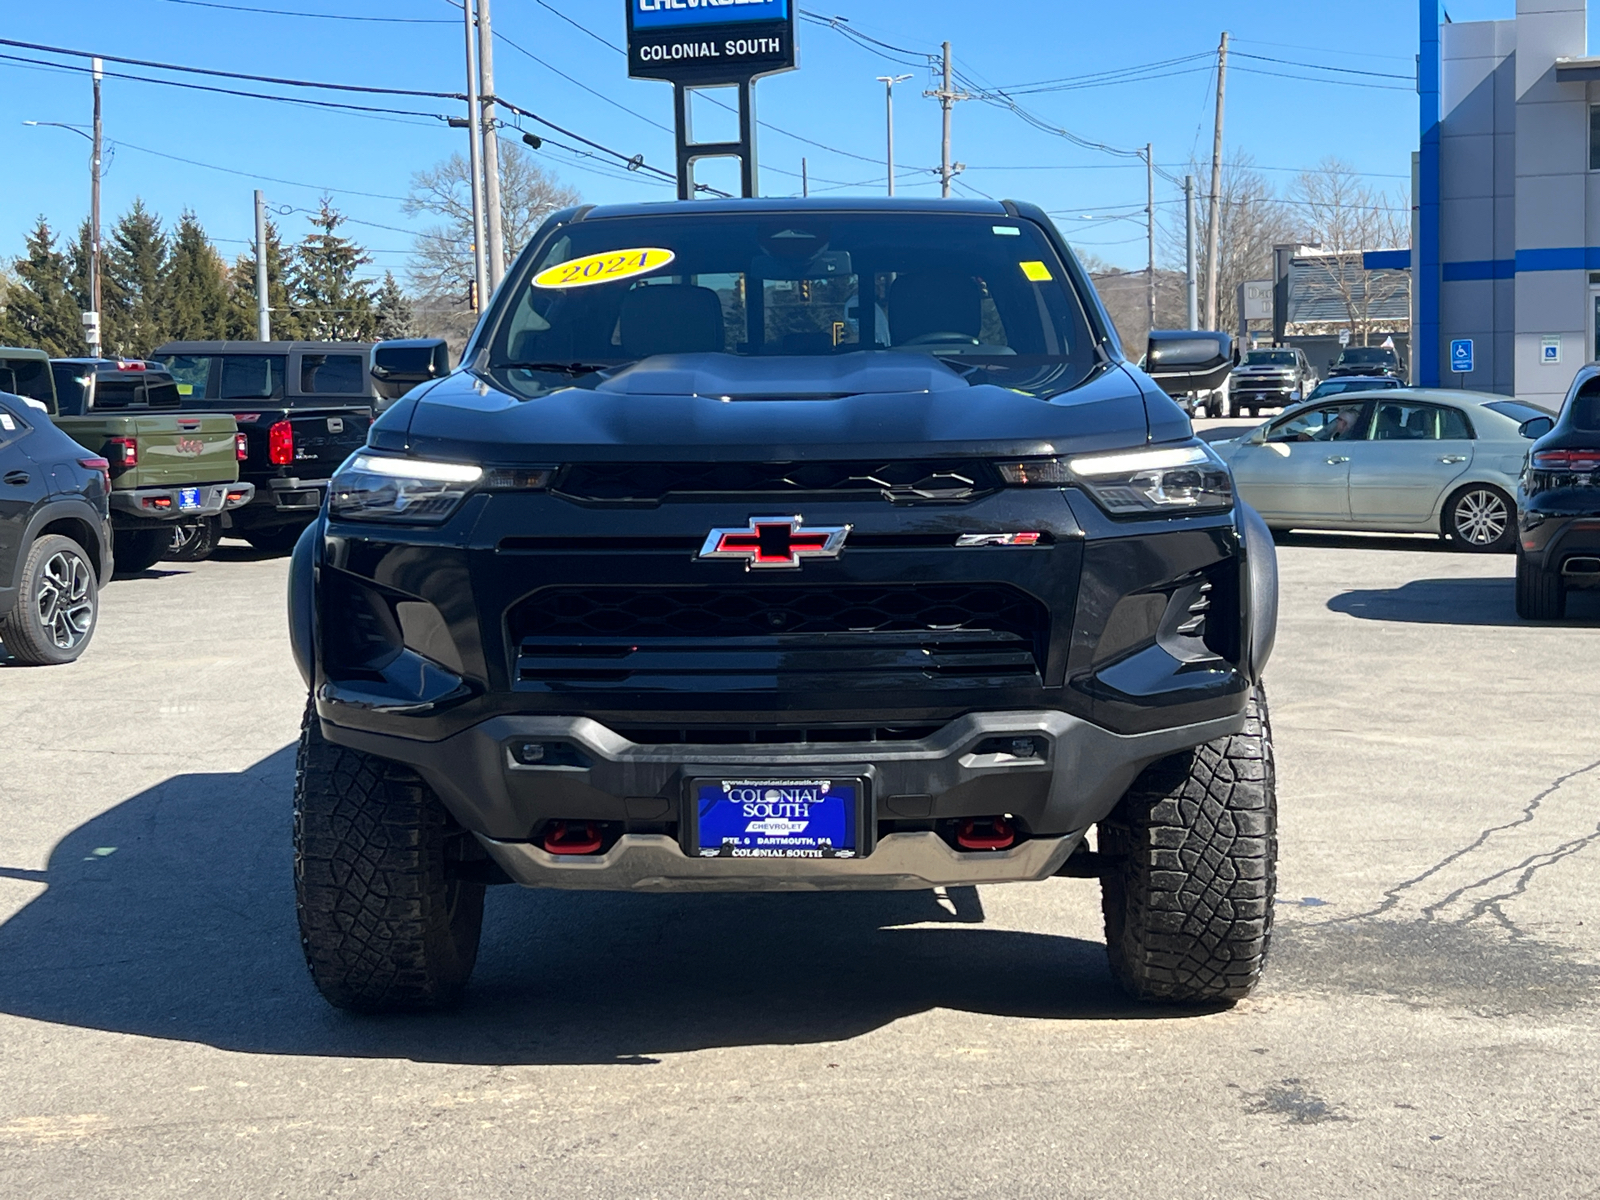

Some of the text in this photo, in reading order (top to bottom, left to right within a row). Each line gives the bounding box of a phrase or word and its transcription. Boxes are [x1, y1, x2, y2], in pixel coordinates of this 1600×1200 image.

[640, 38, 780, 61] COLONIAL SOUTH
[560, 252, 649, 283] 2024
[176, 436, 204, 455] Jeep
[728, 789, 825, 803] COLONIAL
[743, 803, 810, 817] SOUTH
[744, 837, 751, 845] 6
[757, 837, 816, 846] DARTMOUTH,
[732, 848, 823, 857] COLONIAL SOUTH
